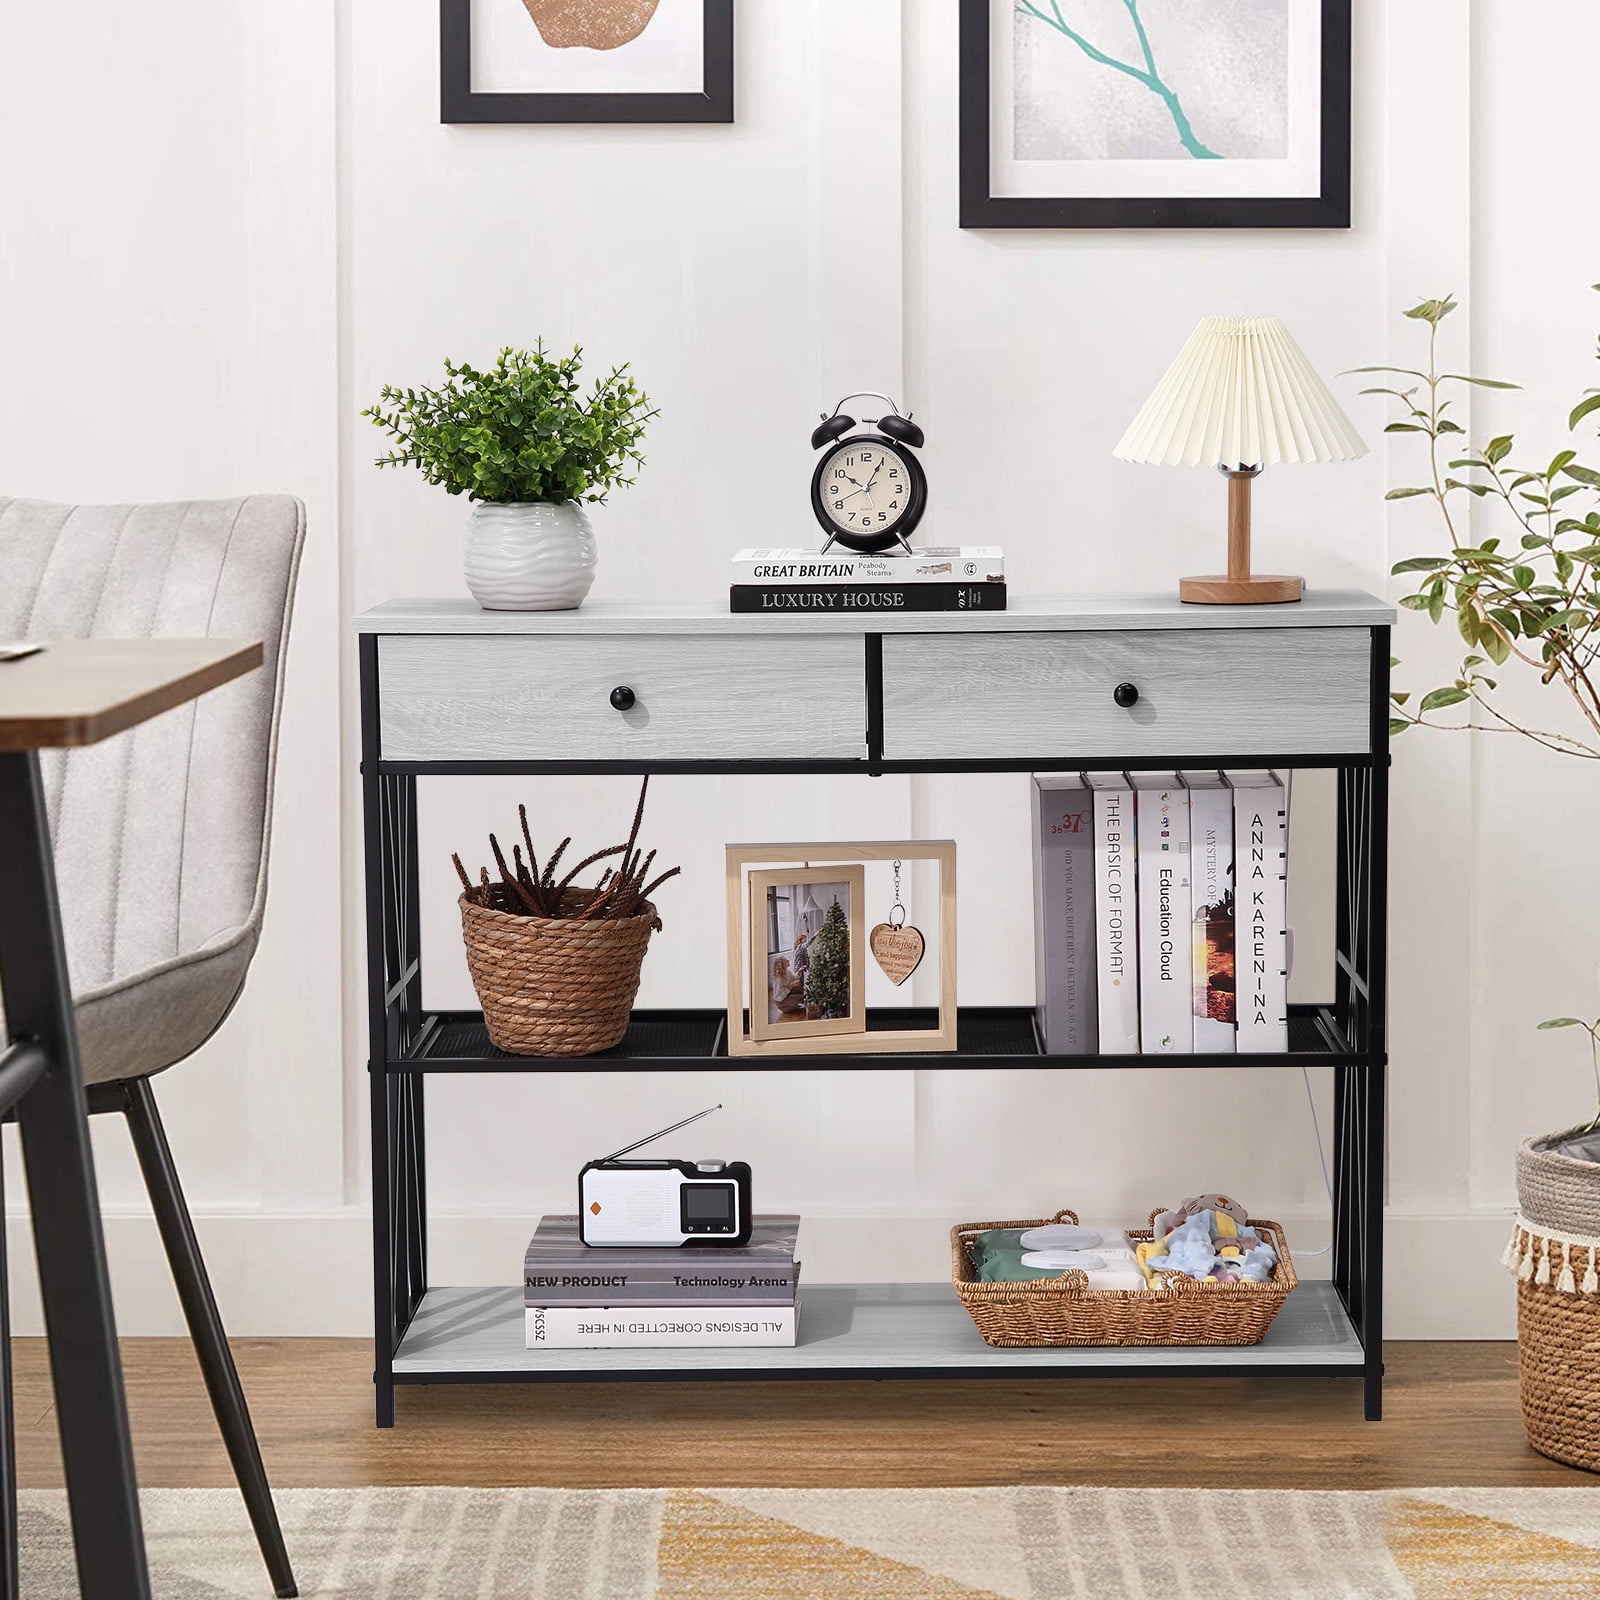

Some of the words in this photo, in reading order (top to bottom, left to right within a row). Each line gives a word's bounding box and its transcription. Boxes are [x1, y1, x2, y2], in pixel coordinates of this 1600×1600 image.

[846, 457, 854, 466] 11
[860, 453, 872, 462] 12
[834, 469, 846, 479] 10
[889, 468, 898, 478] 2
[830, 485, 839, 495] 9
[895, 484, 903, 494] 3
[834, 500, 844, 510] 8
[888, 500, 898, 510] 4
[848, 512, 857, 522] 7
[862, 516, 871, 526] 6
[878, 512, 887, 521] 5
[753, 564, 797, 578] GREAT
[799, 564, 854, 577] BRITAIN
[858, 562, 888, 570] Peabody
[762, 593, 838, 608] LUXURY
[842, 592, 905, 607] HOUSE
[1106, 795, 1120, 827] THE
[1050, 825, 1063, 834] 36
[1250, 813, 1264, 879] ANNA
[1064, 849, 1073, 865] DID
[1107, 832, 1121, 878] BASIC
[1206, 829, 1217, 882] MYSTERY
[1064, 866, 1073, 885] YOU
[1108, 883, 1122, 904] OF
[1206, 884, 1217, 900] OF
[1065, 887, 1074, 914] MAKE
[1159, 868, 1173, 938] Education
[1066, 916, 1075, 964] DIFFERENT
[1109, 909, 1124, 976] FORMAT
[1160, 940, 1173, 981] Cloud
[1252, 891, 1266, 1025] KARENINA
[1067, 967, 1076, 1010] BETWEEN
[525, 1276, 559, 1287] NEW
[562, 1276, 628, 1287] PRODUCT
[673, 1276, 745, 1289] Technology
[748, 1276, 787, 1287] Arena
[577, 1323, 610, 1334] HERE
[613, 1323, 625, 1333] IN
[628, 1323, 702, 1334] CORECTTED
[705, 1322, 759, 1333] DESIGNS
[761, 1322, 783, 1332] ALL
